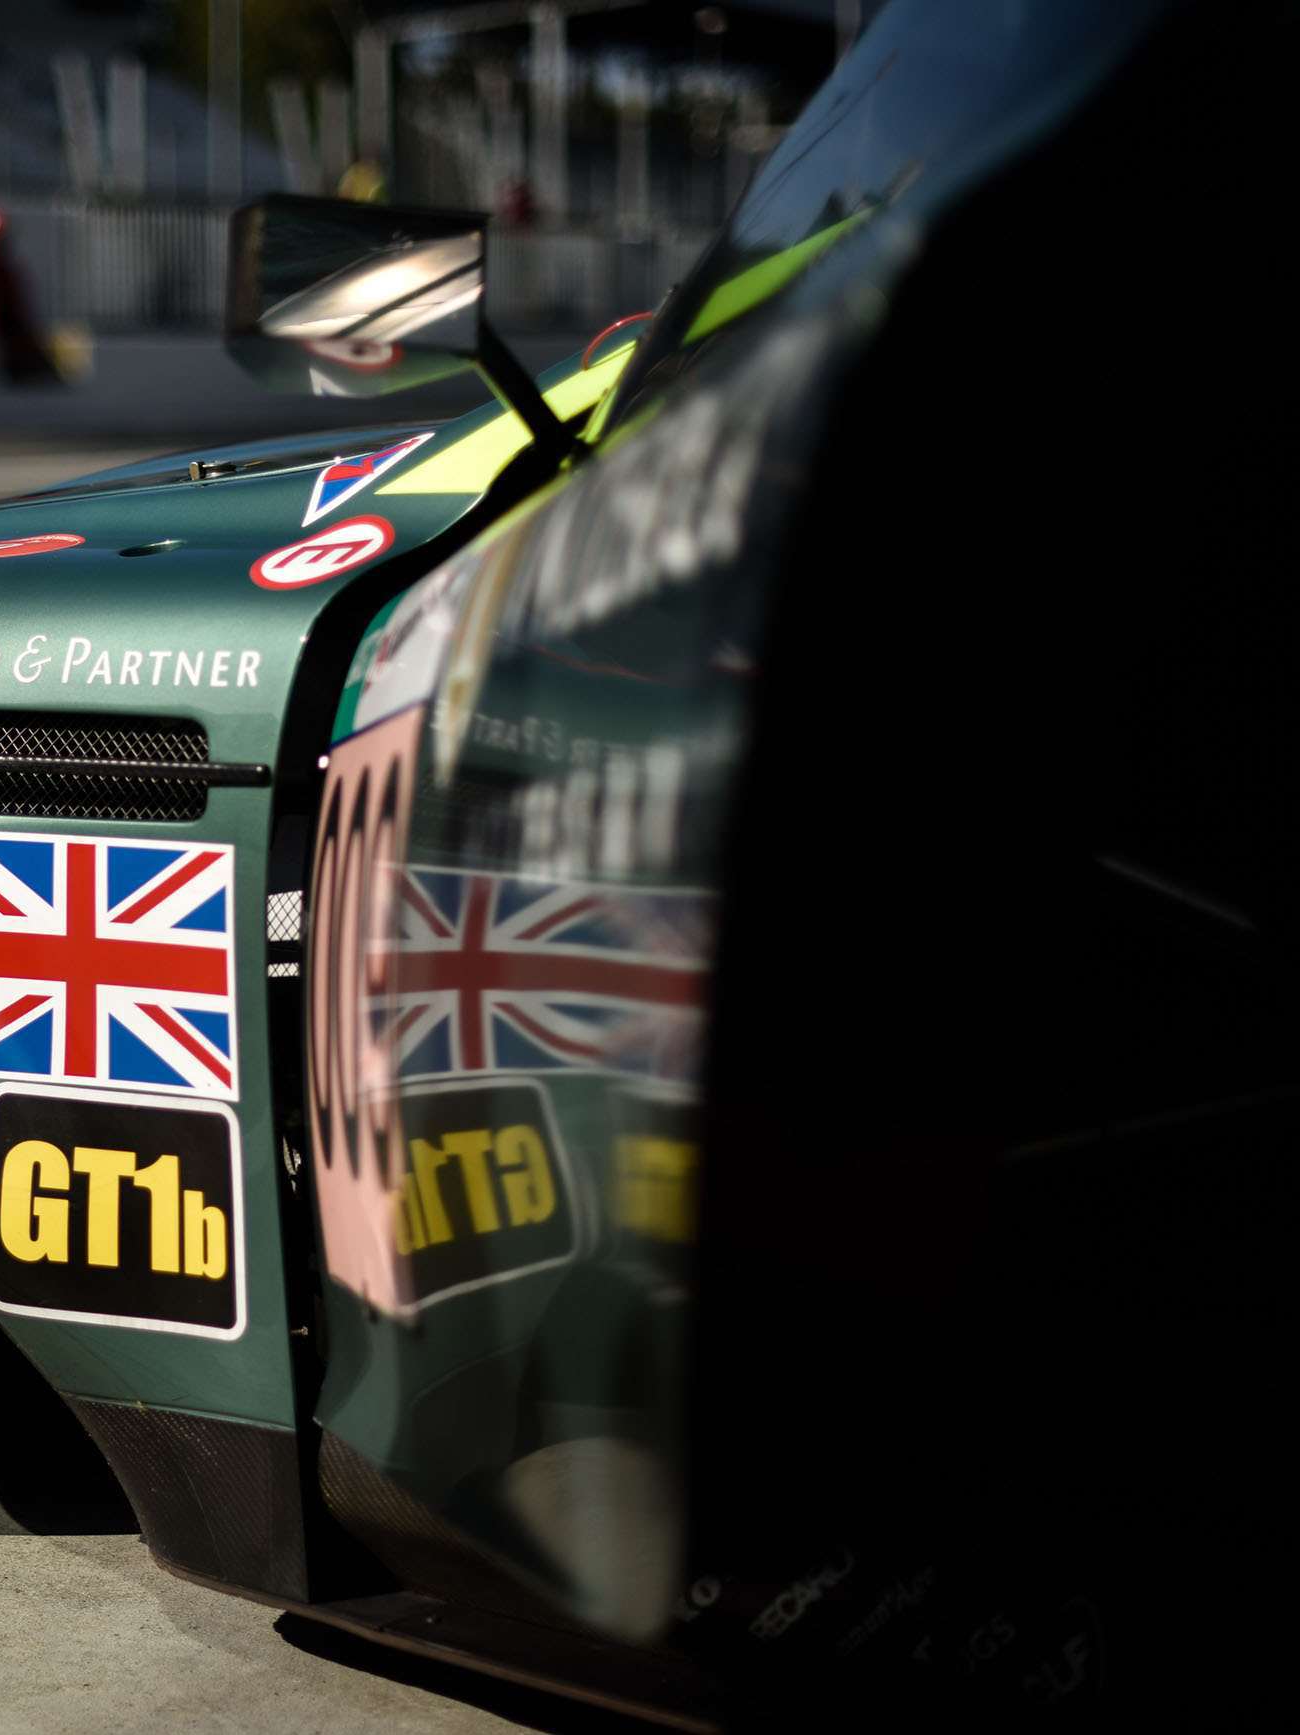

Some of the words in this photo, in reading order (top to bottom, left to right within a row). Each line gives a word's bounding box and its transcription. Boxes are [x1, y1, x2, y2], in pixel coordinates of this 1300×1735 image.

[13, 634, 52, 683] &
[62, 637, 261, 688] PARTNER
[0, 1139, 227, 1280] GT1b
